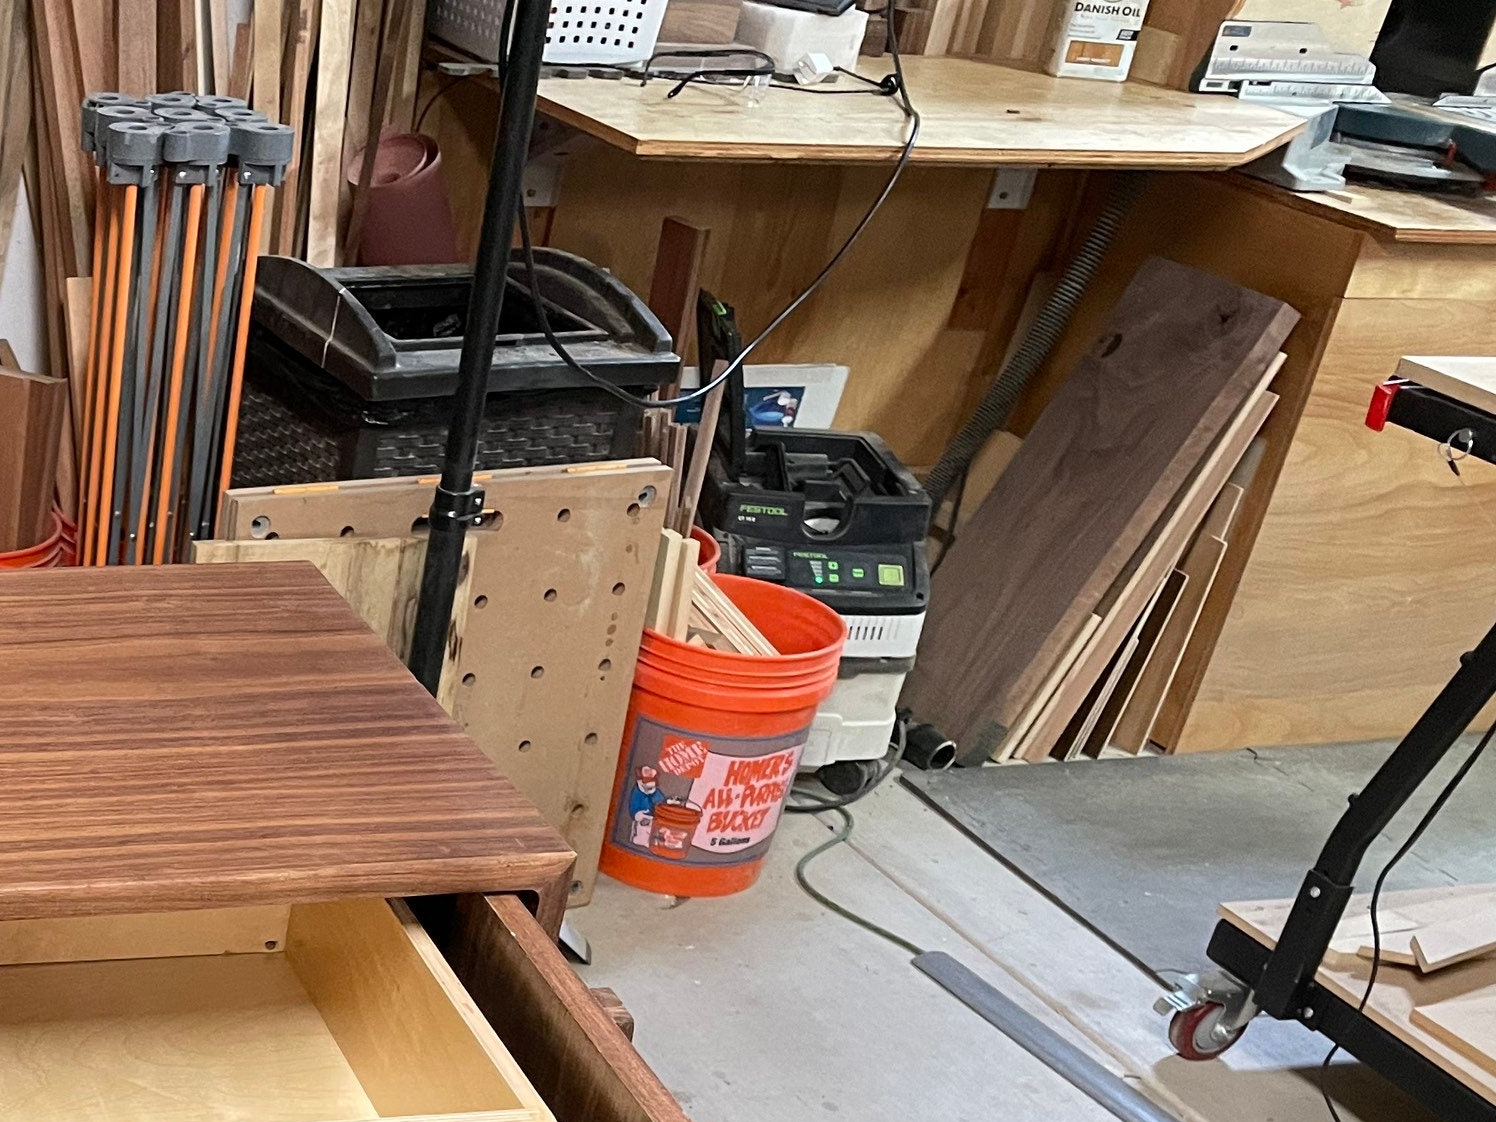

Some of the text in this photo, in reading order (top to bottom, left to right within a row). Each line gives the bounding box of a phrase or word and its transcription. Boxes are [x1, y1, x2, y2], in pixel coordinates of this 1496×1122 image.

[1075, 2, 1141, 17] DANISH OIL
[739, 504, 788, 516] FESTOOL
[658, 741, 708, 773] HOME
[666, 741, 685, 755] THE
[673, 755, 705, 776] DEPOT
[723, 751, 794, 787] HOMER'S
[707, 806, 771, 833] BUCKET
[710, 836, 751, 846] 5 Gallons
